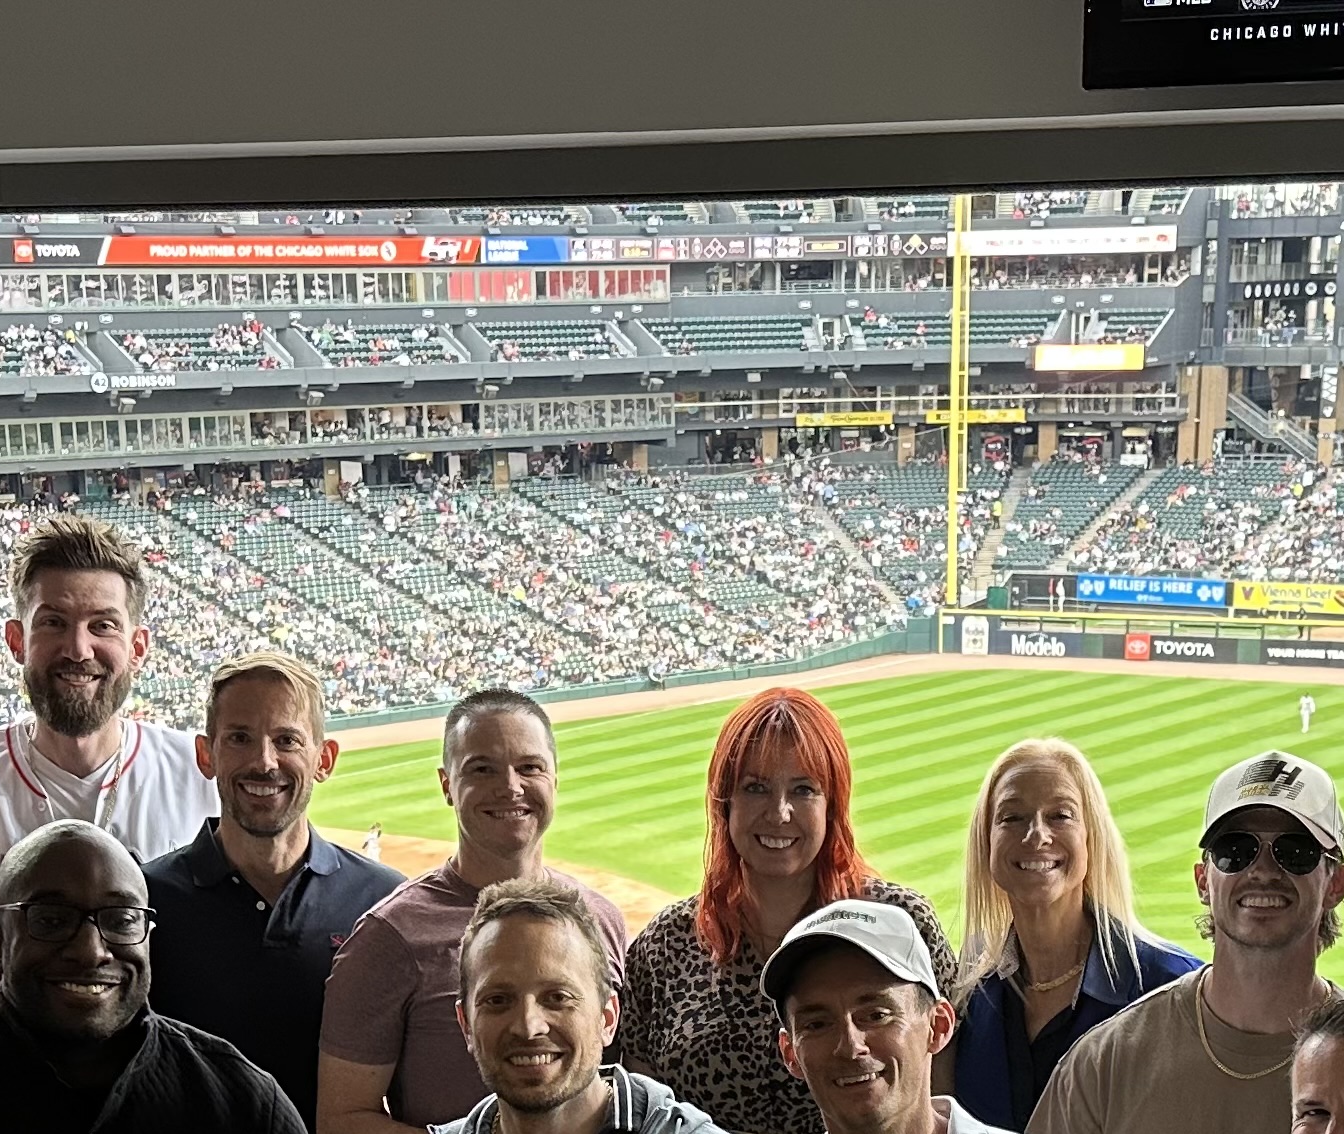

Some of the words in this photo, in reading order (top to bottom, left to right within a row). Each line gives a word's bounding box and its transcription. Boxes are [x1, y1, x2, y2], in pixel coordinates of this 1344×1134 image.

[1209, 25, 1292, 41] CHICAGO
[35, 244, 80, 258] TOYOTA
[149, 244, 187, 258] PROUD
[188, 244, 235, 258] PARTNER
[236, 244, 252, 258] OF
[253, 245, 274, 258] THE
[275, 245, 321, 258] CHICAGO
[322, 245, 356, 258] WHITE
[357, 245, 379, 258] SOX
[111, 374, 176, 388] ROBINSON
[1109, 578, 1147, 592] RELIEF
[1149, 579, 1160, 593] IS
[1162, 580, 1193, 595] HERE
[1260, 584, 1302, 598] Vienna
[1306, 585, 1332, 600] Beef
[1011, 633, 1066, 657] Modelo
[1154, 640, 1215, 658] TOYOTA
[1266, 647, 1295, 659] YOUR
